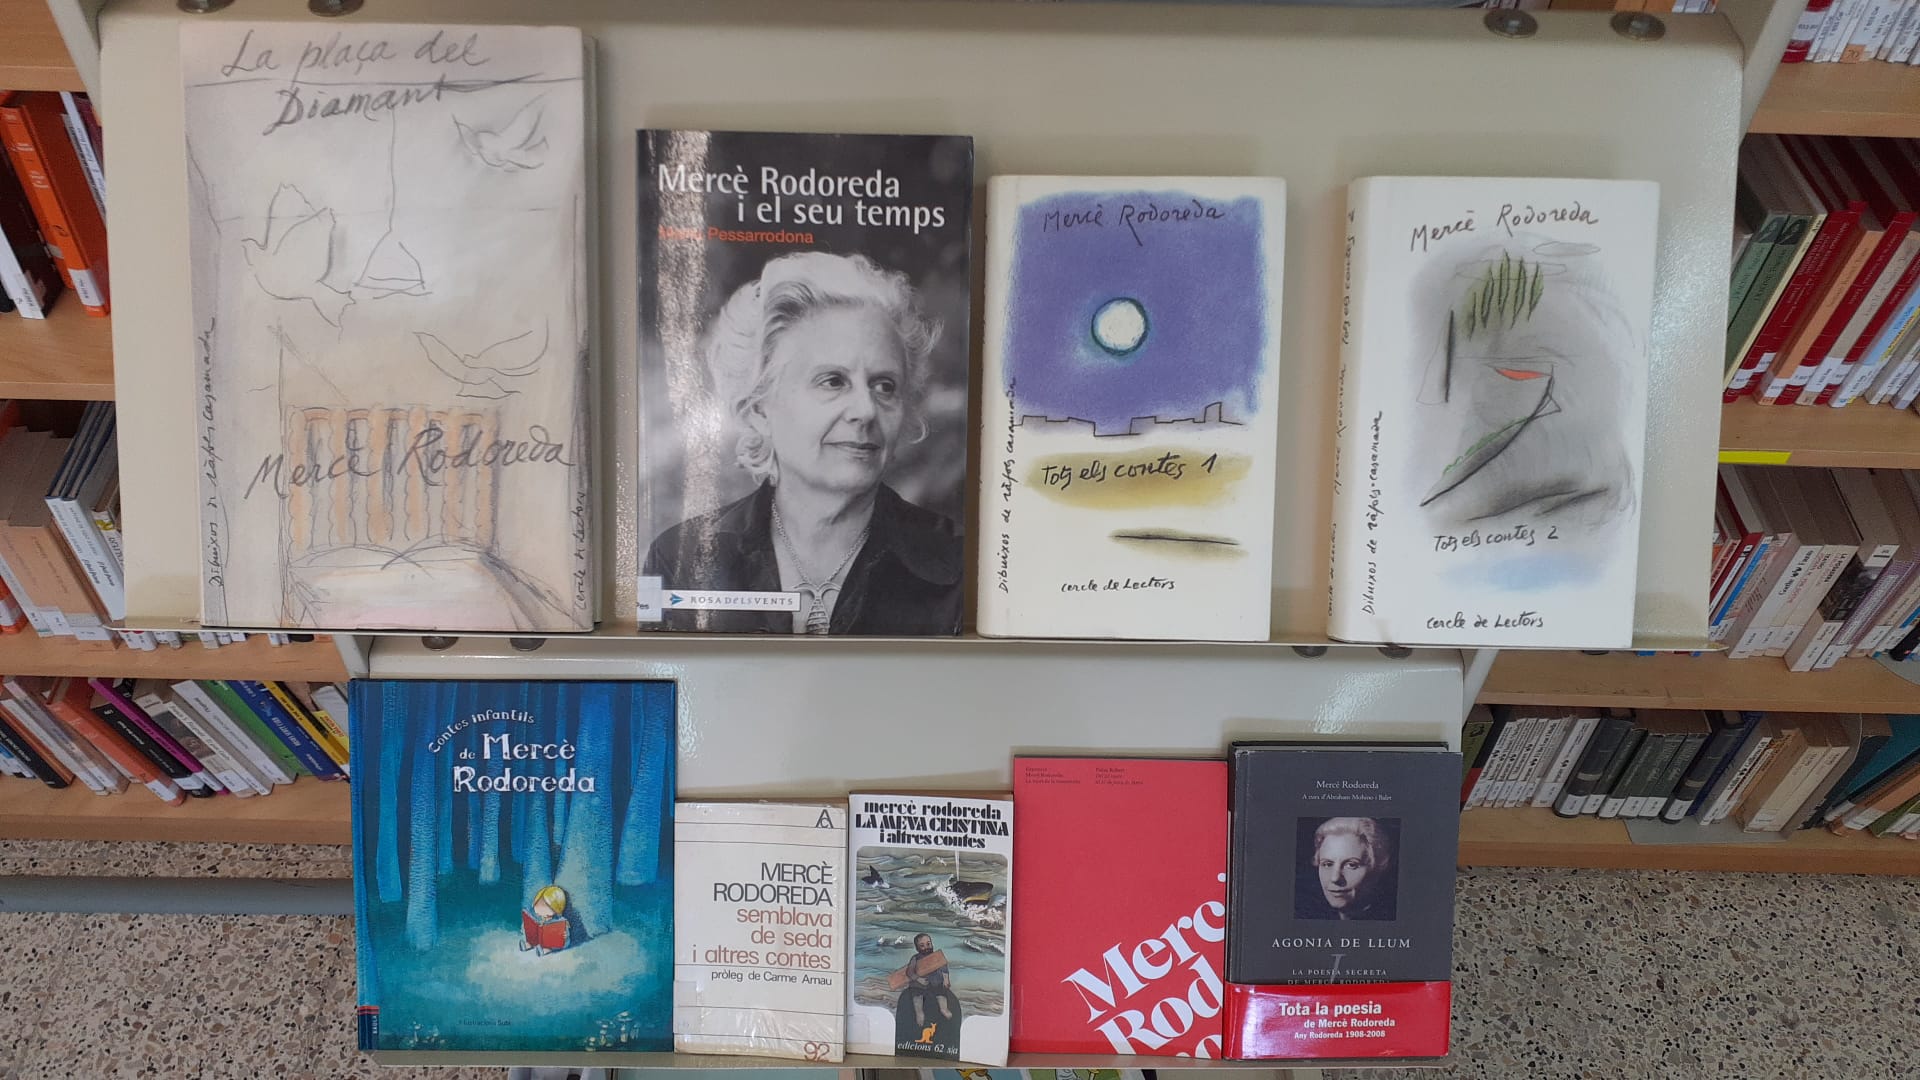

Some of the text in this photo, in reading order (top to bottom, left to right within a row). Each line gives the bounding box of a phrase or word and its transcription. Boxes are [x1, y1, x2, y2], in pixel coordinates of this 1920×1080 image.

[221, 30, 492, 91] La plaça del
[262, 74, 449, 136] Diamant
[658, 164, 901, 198] Mercè Rodoreda
[737, 195, 945, 234] i el seu temps
[1043, 199, 1226, 247] Mercè Rodoreda
[1496, 201, 1599, 238] Rodoreda
[708, 227, 814, 244] Pessarrodona
[244, 422, 575, 501] Mercè Rodoreda
[1079, 460, 1106, 483] els
[1114, 452, 1186, 479] contes
[1201, 453, 1218, 474] 1
[999, 508, 1011, 523] de
[1366, 539, 1378, 554] de
[1485, 525, 1536, 547] contes
[1547, 526, 1559, 540] 2
[997, 534, 1011, 593] Dibuixos
[1103, 578, 1120, 592] de
[1361, 561, 1377, 615] Dibuixos
[1474, 612, 1490, 628] de
[428, 708, 536, 754] Contes infantils
[459, 733, 576, 760] de Mercè
[453, 765, 595, 793] Rodoreda
[1342, 780, 1379, 790] Rodoreda
[864, 800, 1001, 820] mercè rodoreda
[855, 814, 1010, 836] LA MEVA CRISTINA
[880, 830, 986, 849] i altres contes
[761, 861, 834, 885] MERCÈ
[714, 882, 834, 907] RODOREDA
[737, 906, 833, 928] semblava
[751, 925, 832, 949] de seda
[1272, 937, 1412, 948] AGONIA DE LLUM
[692, 944, 832, 970] i altres contes
[711, 969, 832, 986] pròleg de Carme Arnau
[1279, 1001, 1382, 1016] Tota la poesia
[1304, 1018, 1395, 1028] de Mercè Rodoreda
[1294, 1030, 1386, 1040] Any Rodoreda 1908-2008
[803, 1042, 830, 1063] 92
[897, 1041, 931, 1052] edicions
[934, 1043, 945, 1053] 62
